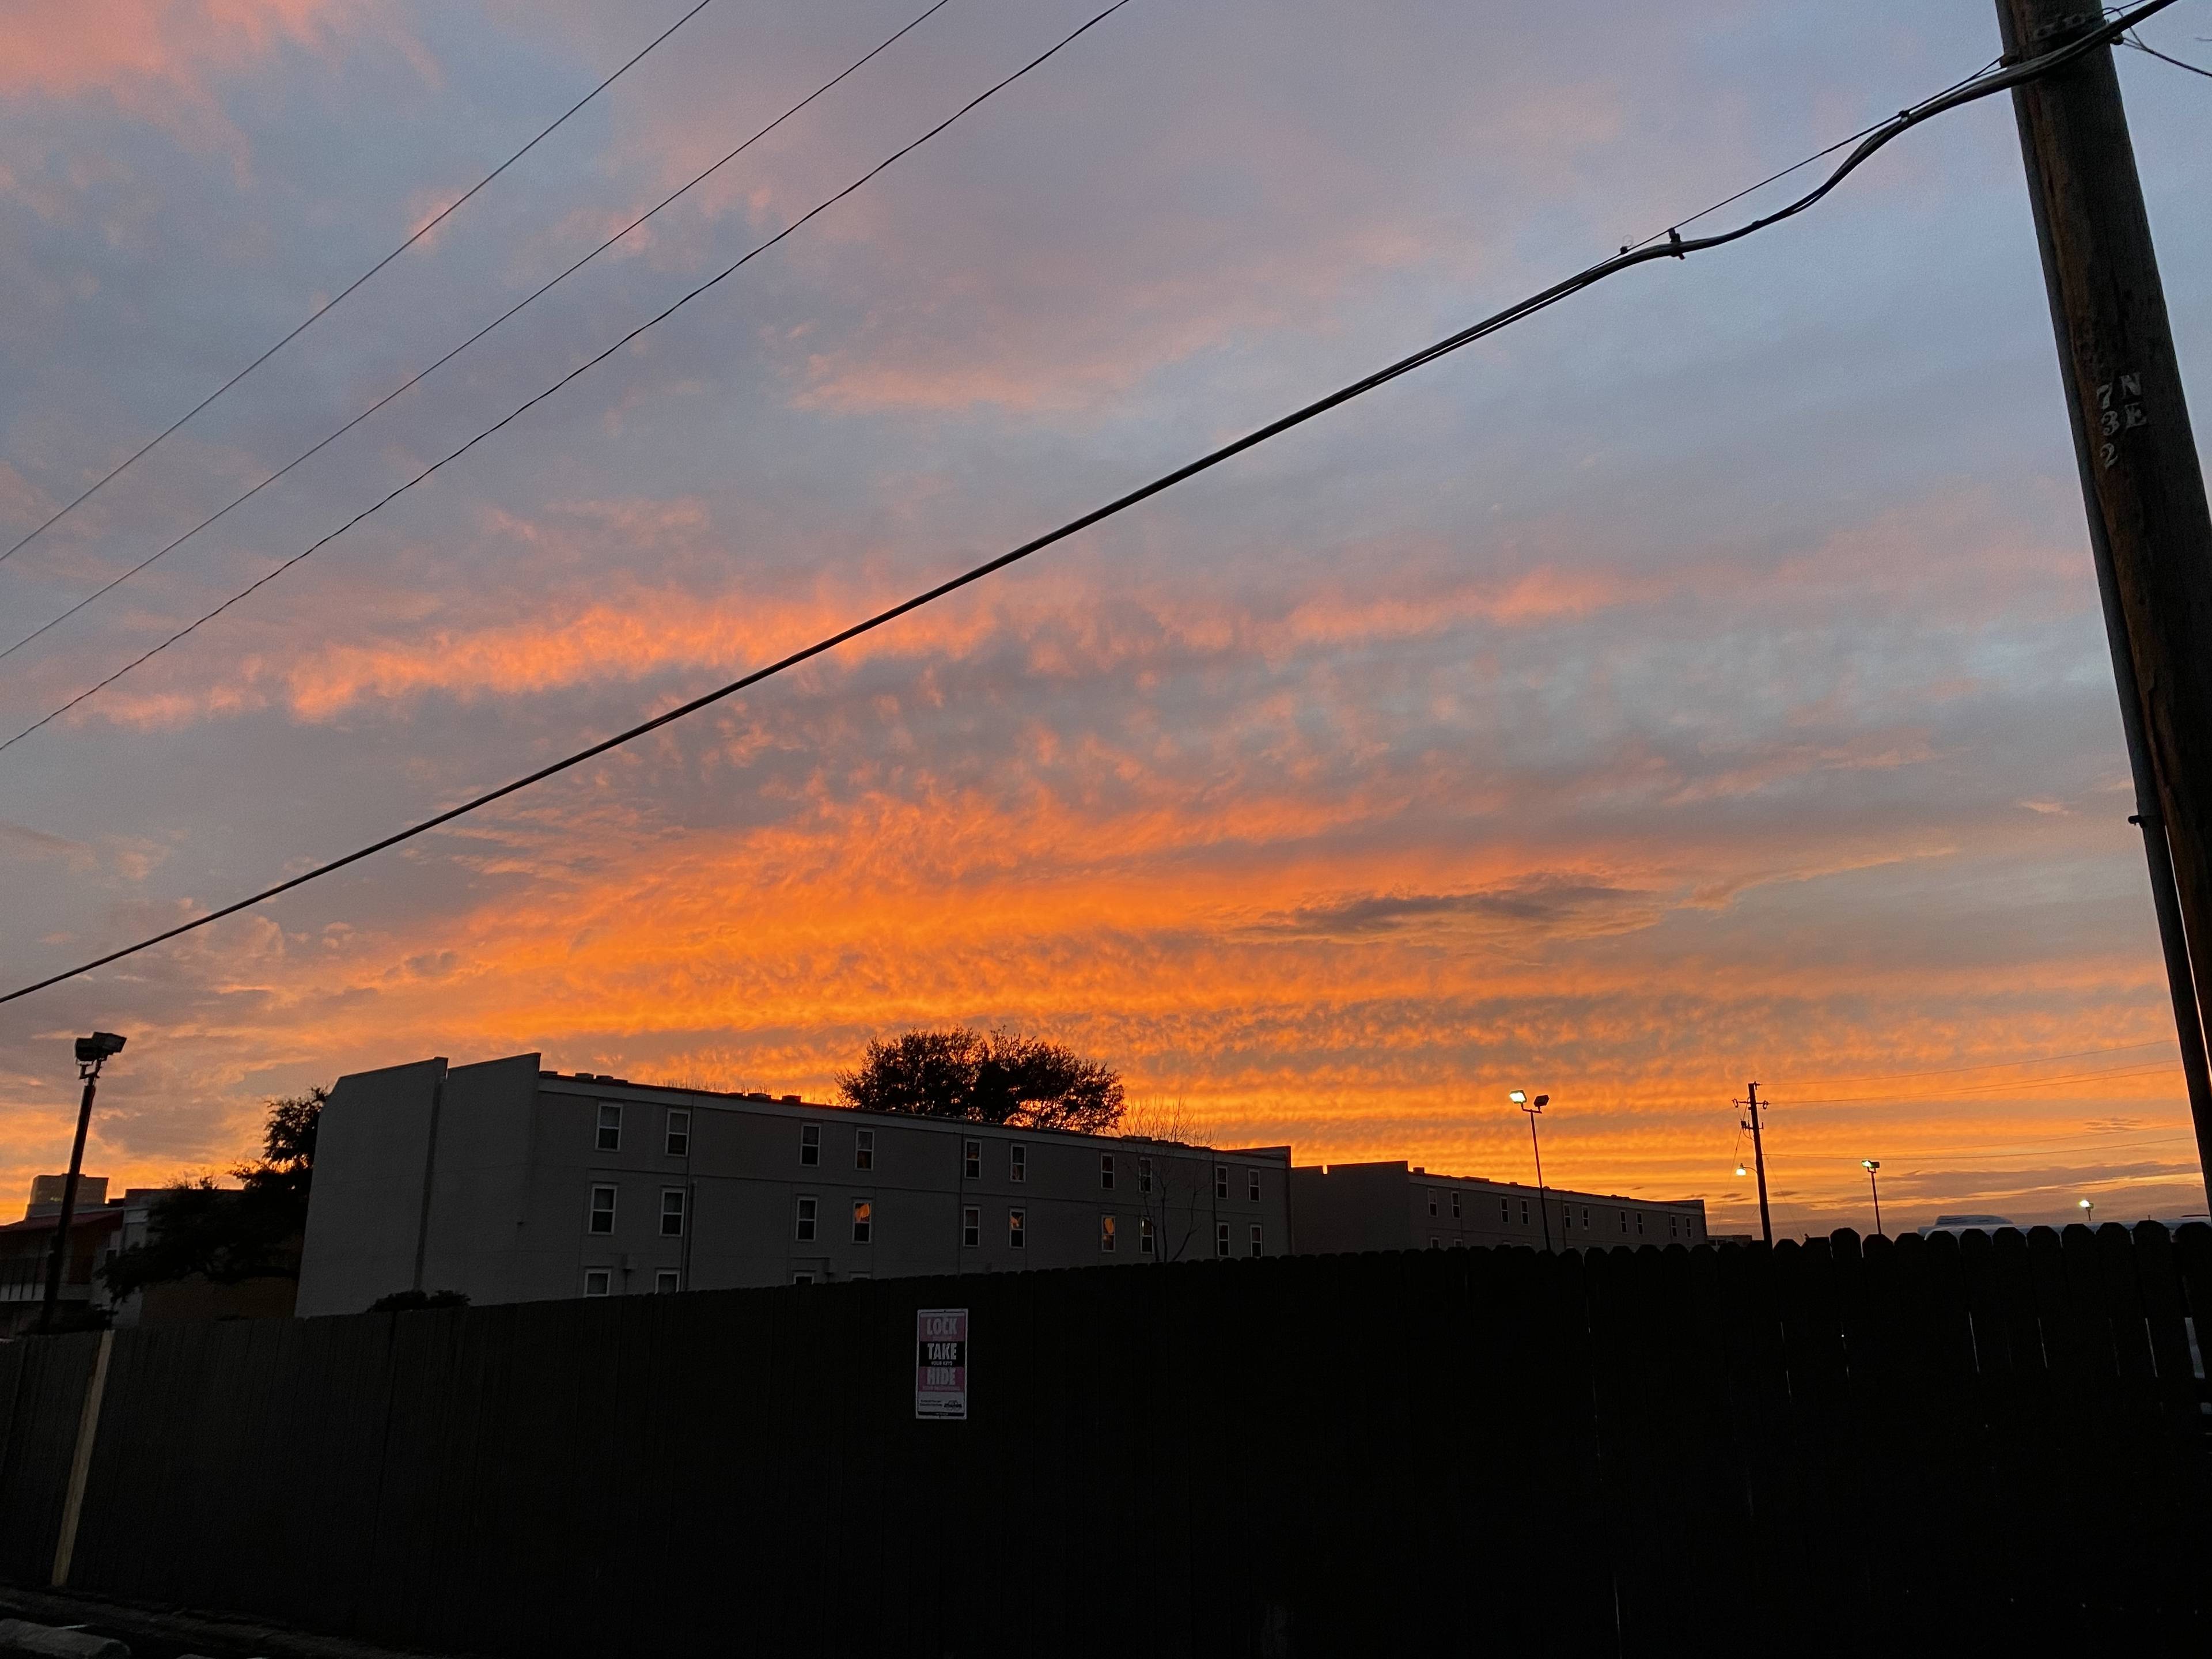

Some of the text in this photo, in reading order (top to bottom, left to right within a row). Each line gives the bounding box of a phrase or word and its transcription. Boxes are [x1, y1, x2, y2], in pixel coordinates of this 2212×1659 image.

[927, 1317, 957, 1335] LOCK
[927, 1343, 957, 1360] TAKE
[926, 1368, 956, 1385] HIDE
